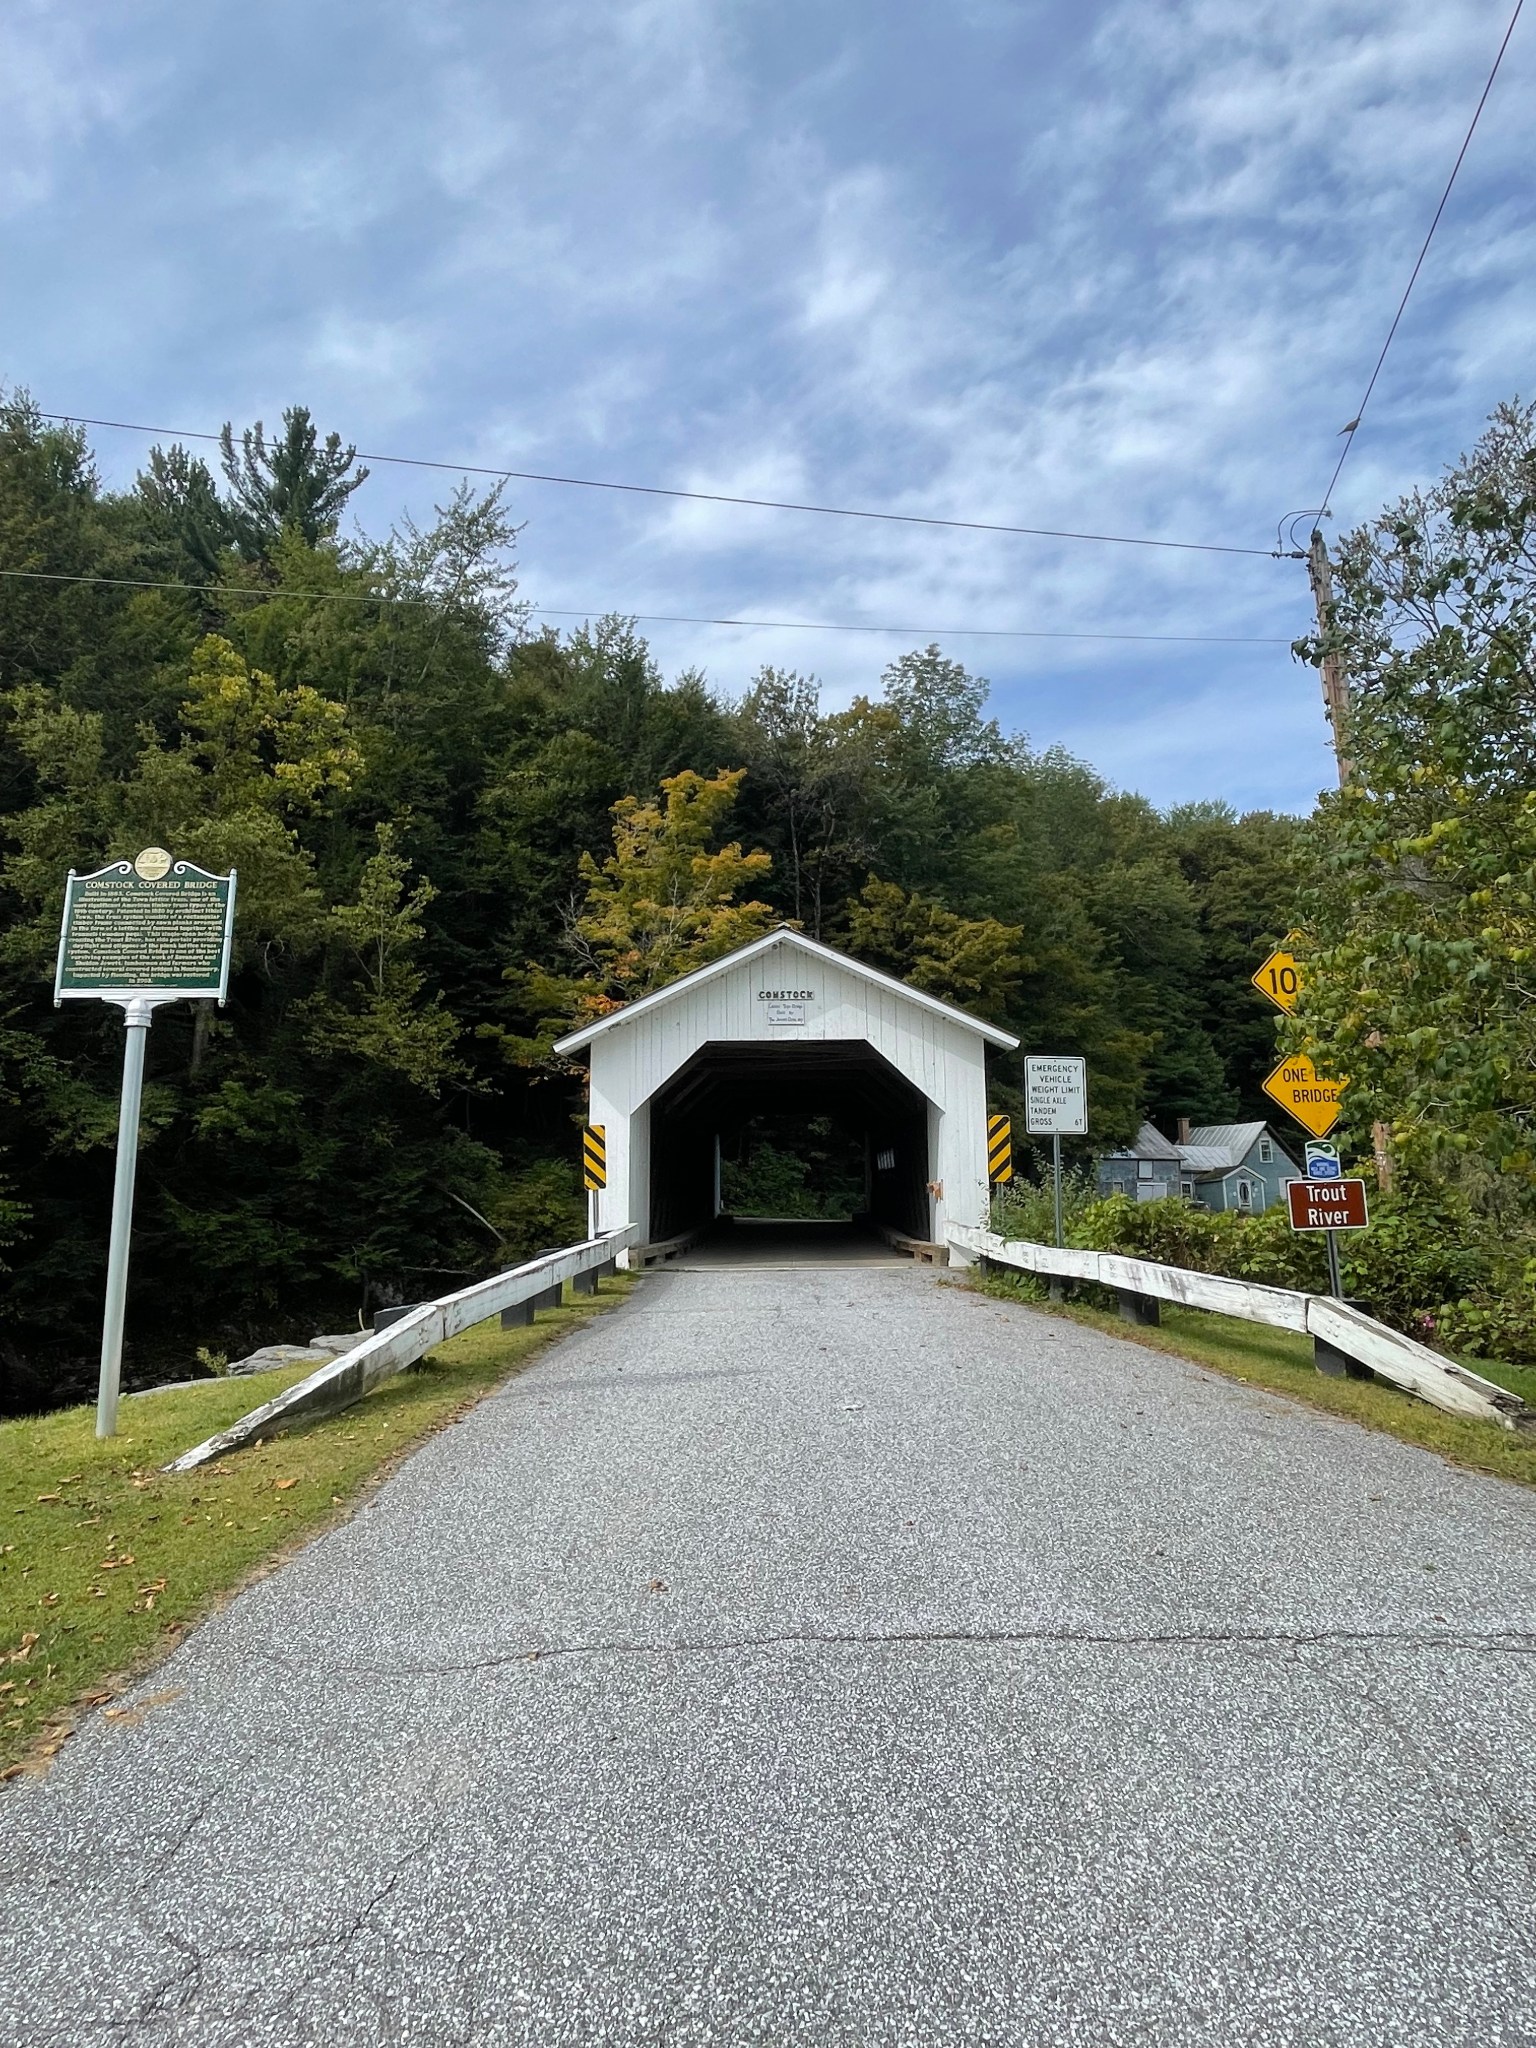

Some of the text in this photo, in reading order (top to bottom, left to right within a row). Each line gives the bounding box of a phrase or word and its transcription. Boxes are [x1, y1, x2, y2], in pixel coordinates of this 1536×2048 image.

[1268, 968, 1297, 994] 10
[758, 990, 814, 999] COMSTOCK
[1031, 1064, 1078, 1072] EMERGENCY
[1282, 1068, 1308, 1082] ONE
[1293, 1088, 1338, 1103] BRIDGE
[1306, 1185, 1347, 1202] Trout
[1308, 1208, 1349, 1225] River
